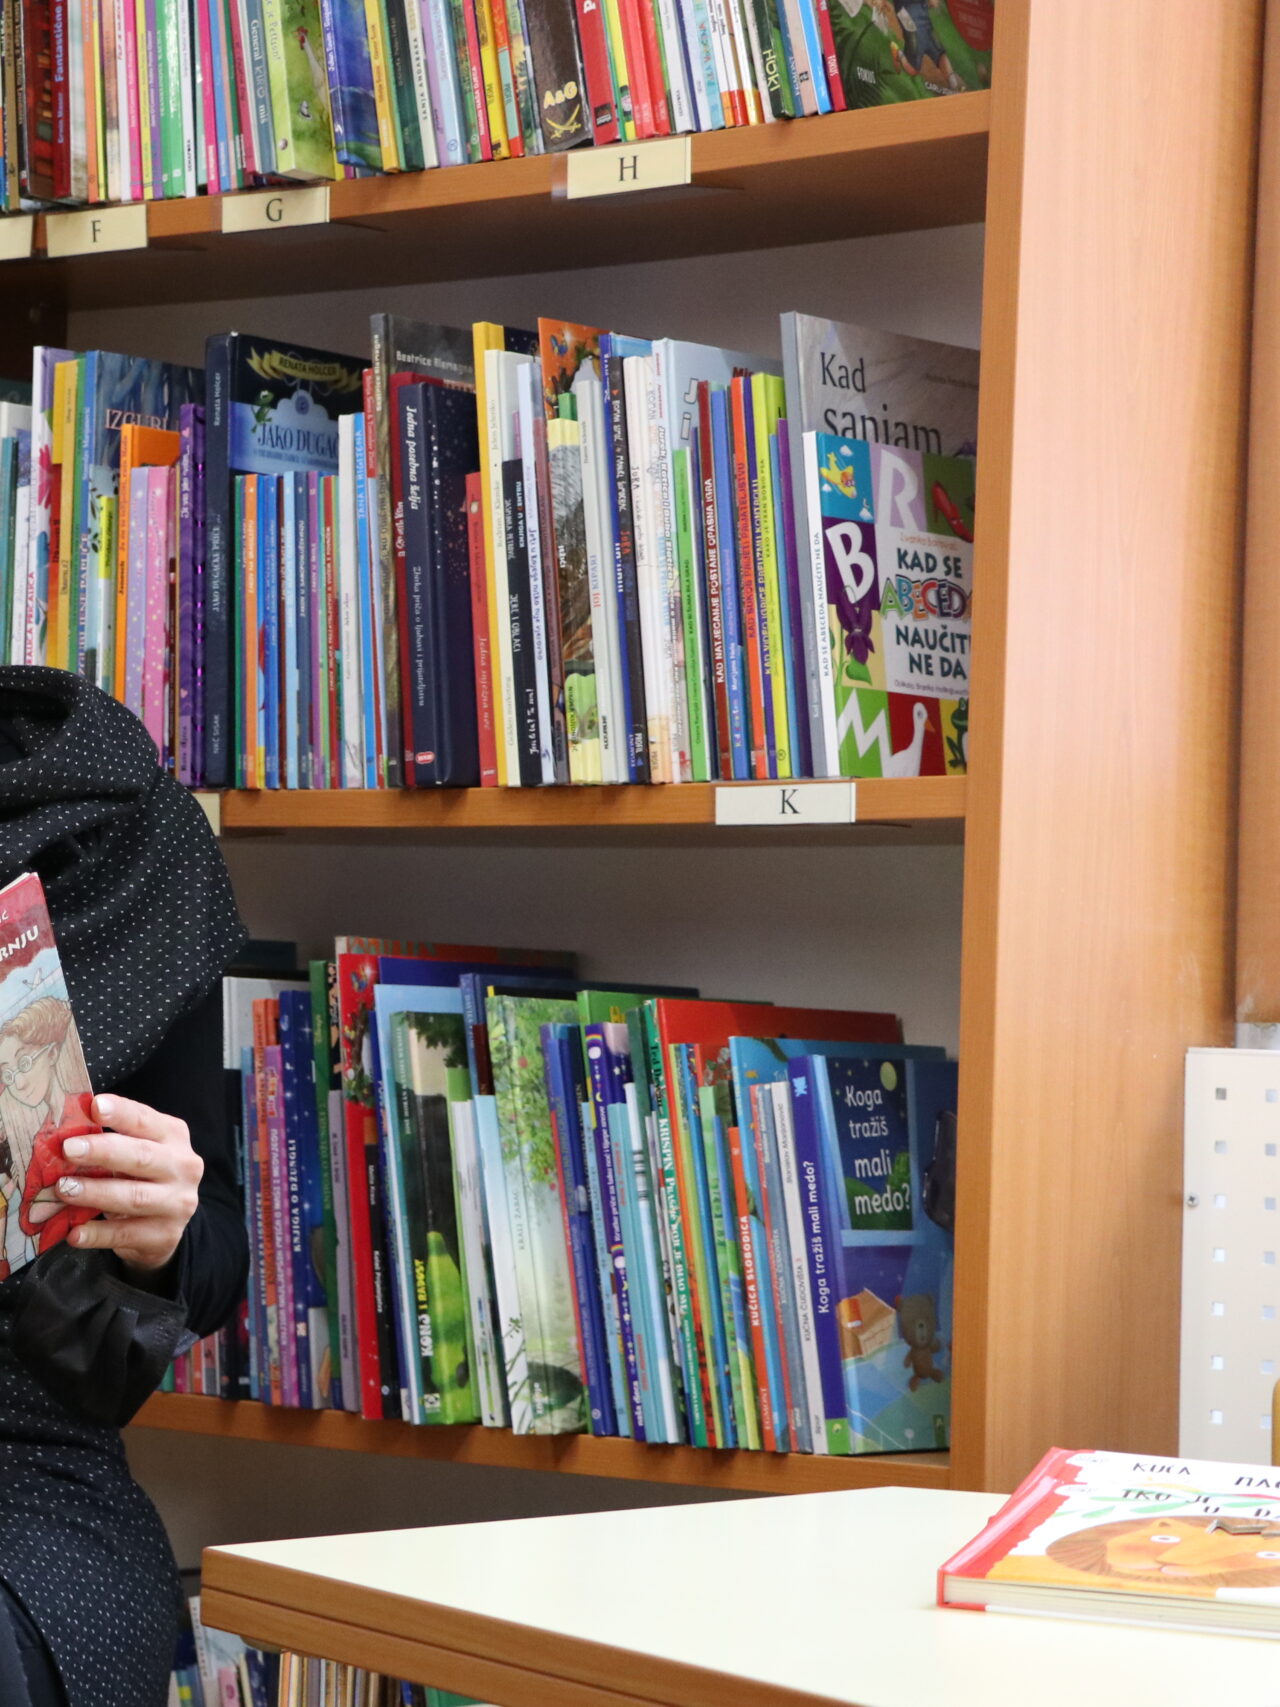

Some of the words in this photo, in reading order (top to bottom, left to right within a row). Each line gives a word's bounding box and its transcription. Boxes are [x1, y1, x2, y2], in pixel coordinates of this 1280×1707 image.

[618, 155, 638, 181] H
[266, 198, 283, 221] G
[91, 220, 101, 242] F
[395, 350, 432, 368] Beatrice
[820, 351, 867, 394] Kad
[405, 405, 418, 439] Jedna
[257, 425, 295, 449] JAKO
[405, 440, 420, 482] posebna
[702, 478, 714, 503] IGRA
[704, 505, 717, 546] OPASNA
[707, 548, 720, 596] POSTANE
[896, 547, 938, 574] KAD
[942, 557, 963, 578] SE
[908, 653, 934, 678] NE
[940, 657, 967, 681] DA
[780, 789, 800, 814] K
[844, 1085, 883, 1108] Koga
[848, 1113, 889, 1141] tražiš
[854, 1149, 892, 1178] mali
[802, 1160, 818, 1202] medo?
[854, 1182, 911, 1216] medo?
[807, 1206, 821, 1233] mali
[816, 1278, 831, 1314] Koga
